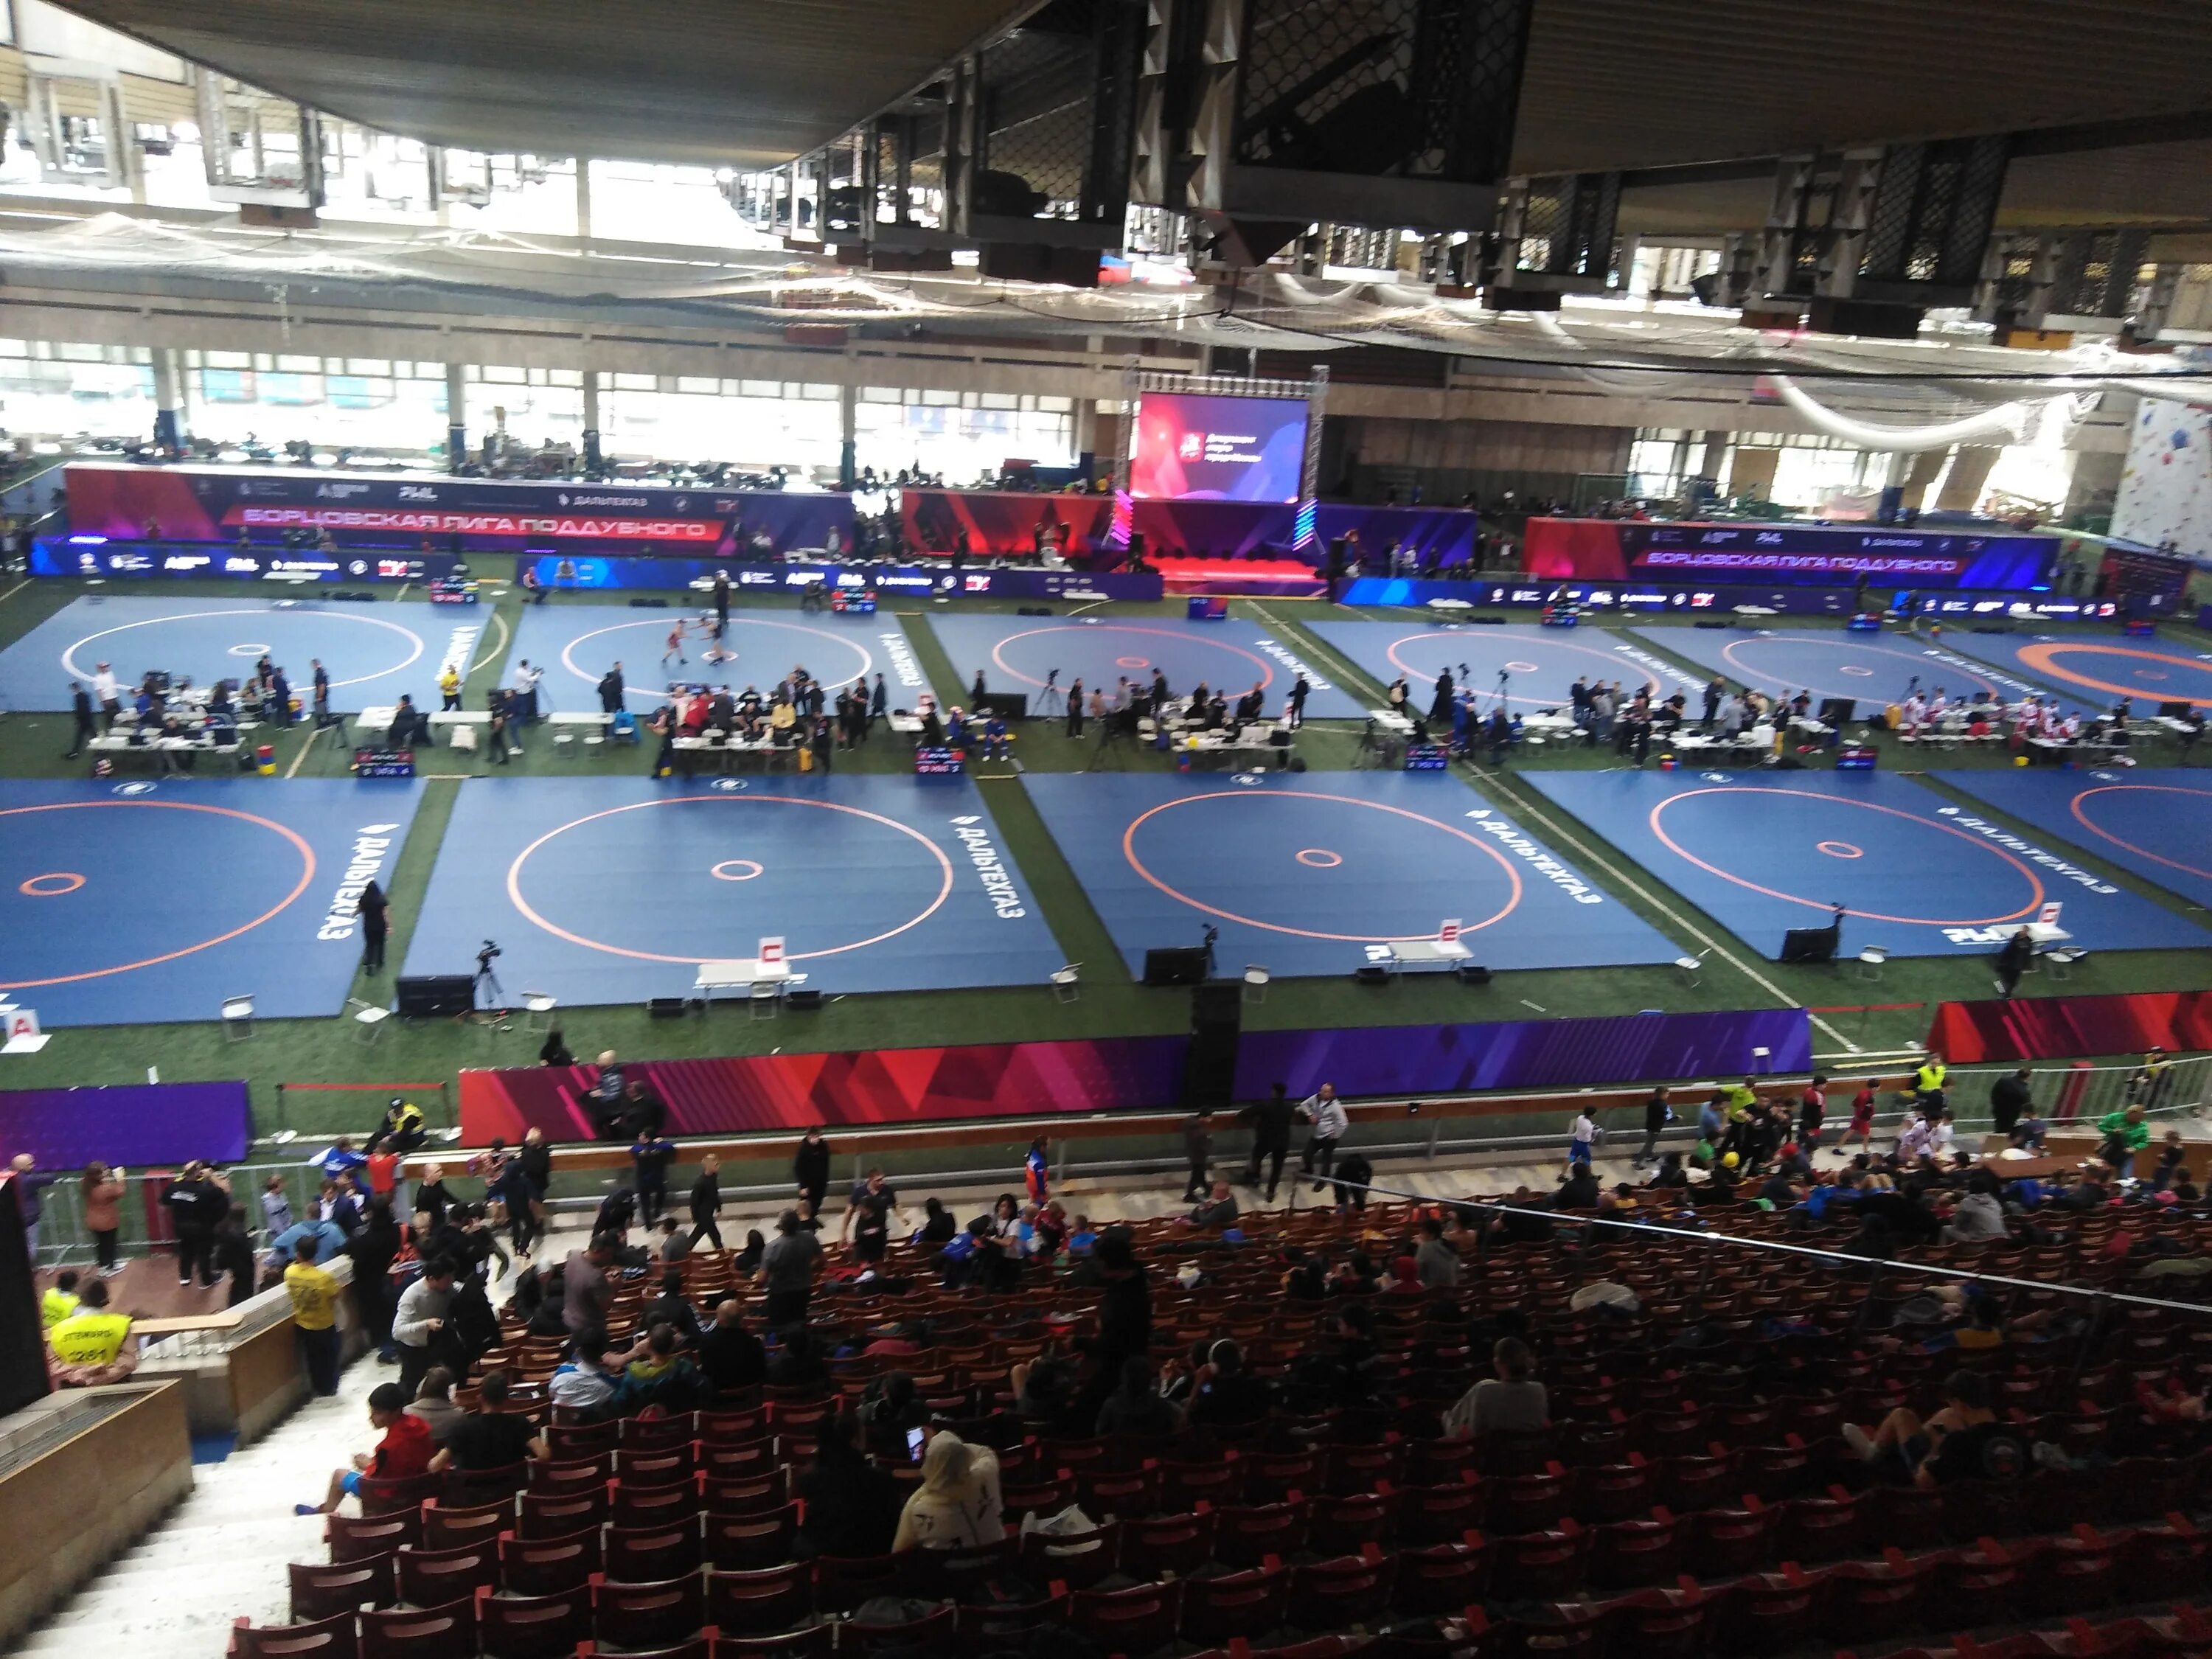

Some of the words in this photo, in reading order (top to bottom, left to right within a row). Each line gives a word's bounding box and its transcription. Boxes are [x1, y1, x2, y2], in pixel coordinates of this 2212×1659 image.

[243, 509, 439, 529] БОРЦОВСКАЯ
[443, 516, 515, 532] ЛИГА
[520, 518, 706, 537] ПОДДУБНОГО
[1646, 552, 1779, 566] БОРЦОВСКАЯ
[1778, 555, 1829, 568] ЛИГА
[1829, 556, 1958, 571] ПОДДУБНОГО
[954, 827, 1026, 919] ДАЛЬТЕХГАЗ
[1475, 821, 1603, 904] ДАЛЬТЕХГАЗ
